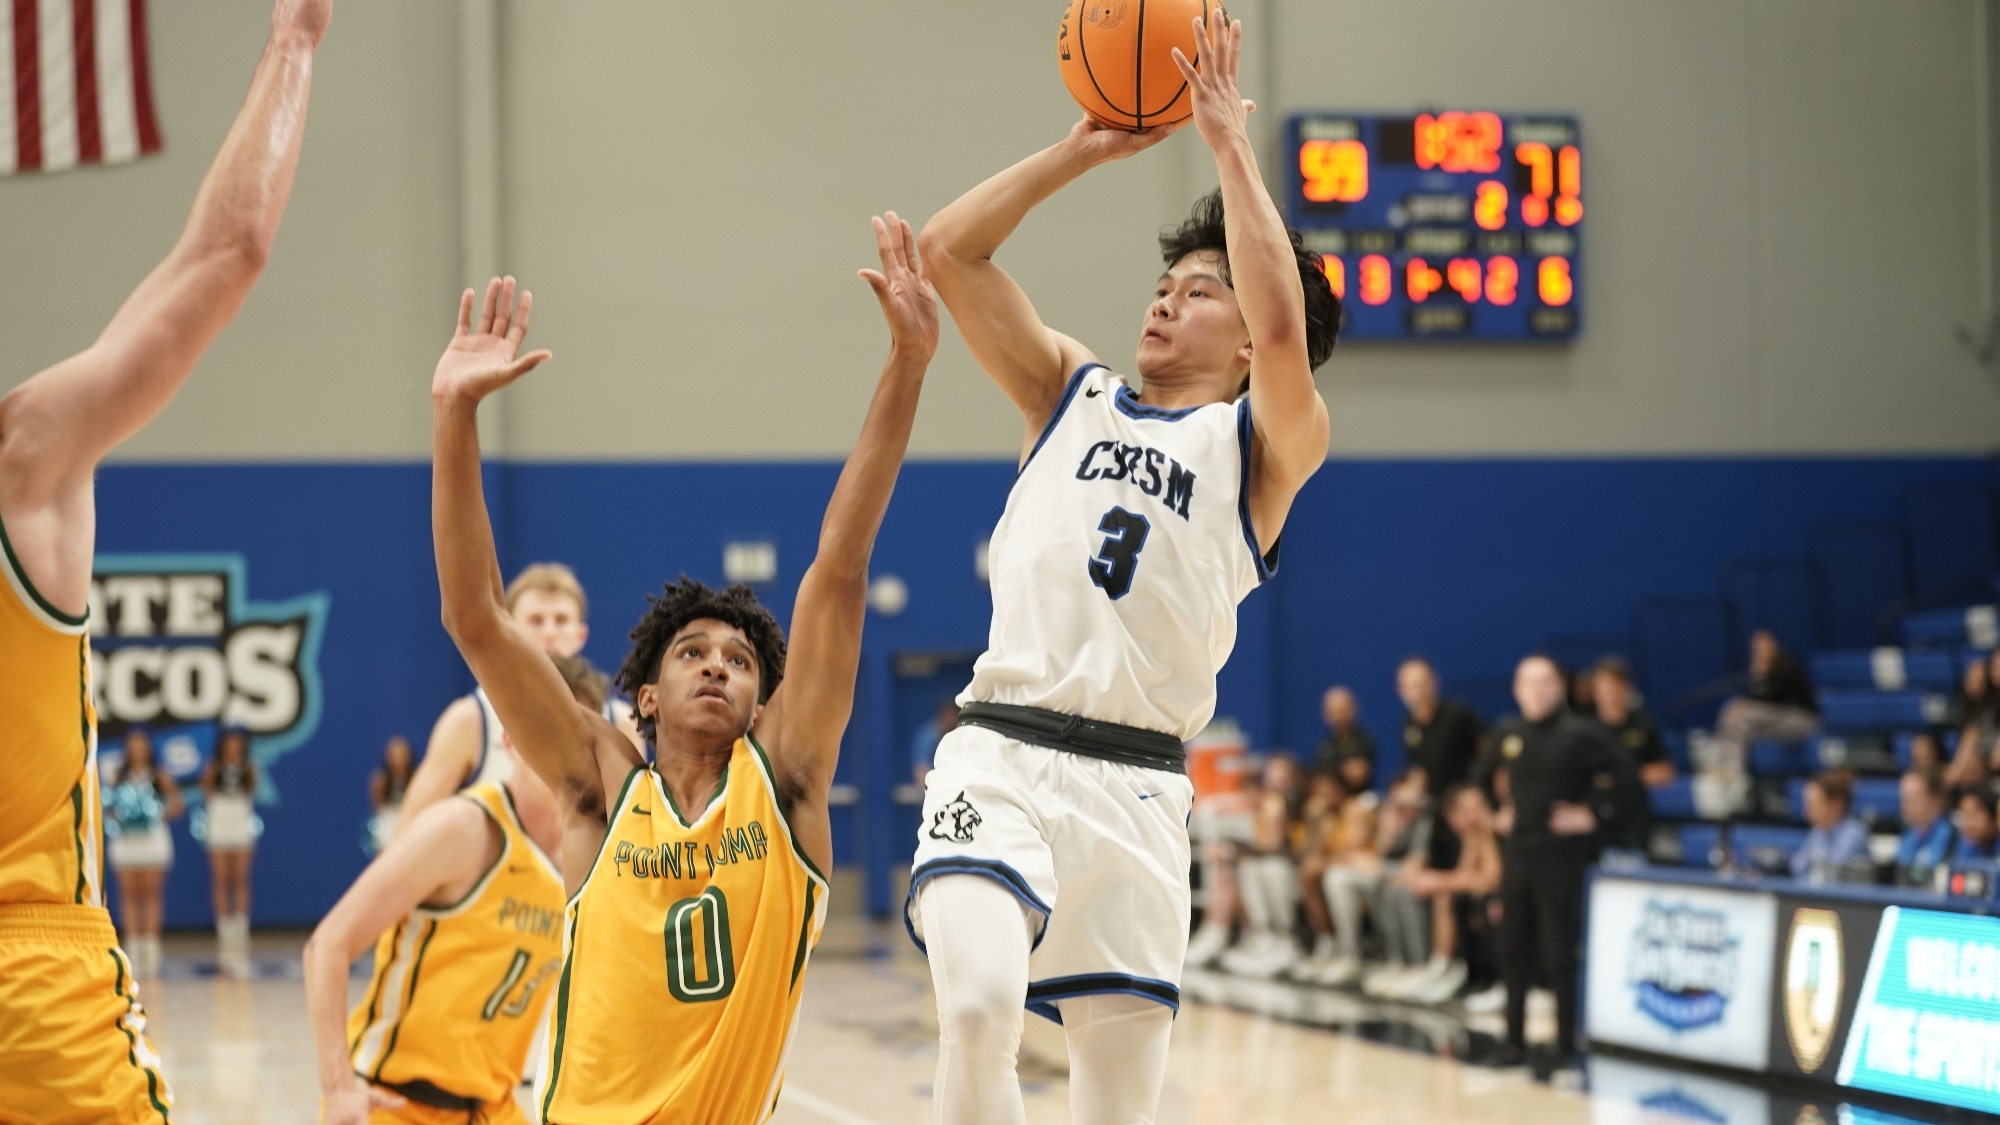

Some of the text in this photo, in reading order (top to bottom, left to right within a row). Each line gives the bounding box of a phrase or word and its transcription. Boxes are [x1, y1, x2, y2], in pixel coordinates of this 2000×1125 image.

[1300, 139, 1368, 202] 59
[1515, 142, 1580, 199] 71
[1360, 254, 1391, 305] 3
[1538, 256, 1572, 306] 6
[1088, 505, 1151, 600] 3
[614, 841, 697, 879] POINT
[499, 898, 564, 941] POINT
[664, 886, 735, 1003] 0
[1906, 936, 2000, 1004] WELCO
